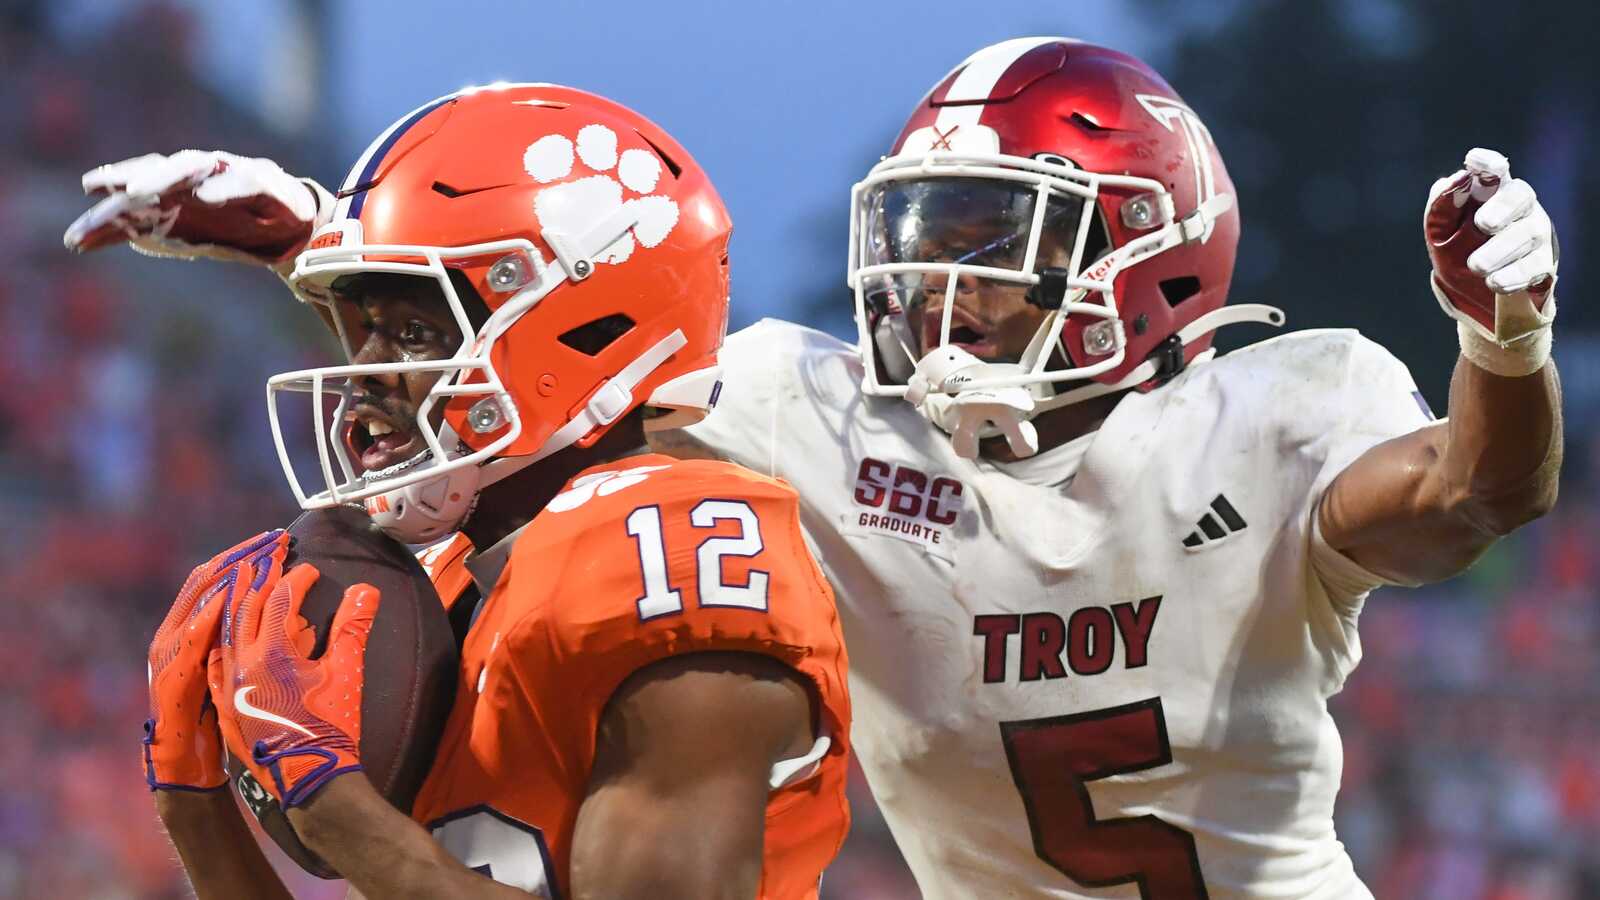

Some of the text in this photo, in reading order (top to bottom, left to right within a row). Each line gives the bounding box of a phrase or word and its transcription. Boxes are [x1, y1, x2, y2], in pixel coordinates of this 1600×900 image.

[854, 457, 963, 525] SBC
[859, 512, 942, 544] GRADUATE
[625, 498, 770, 623] 12
[973, 595, 1163, 683] TROY
[999, 696, 1209, 899] 5
